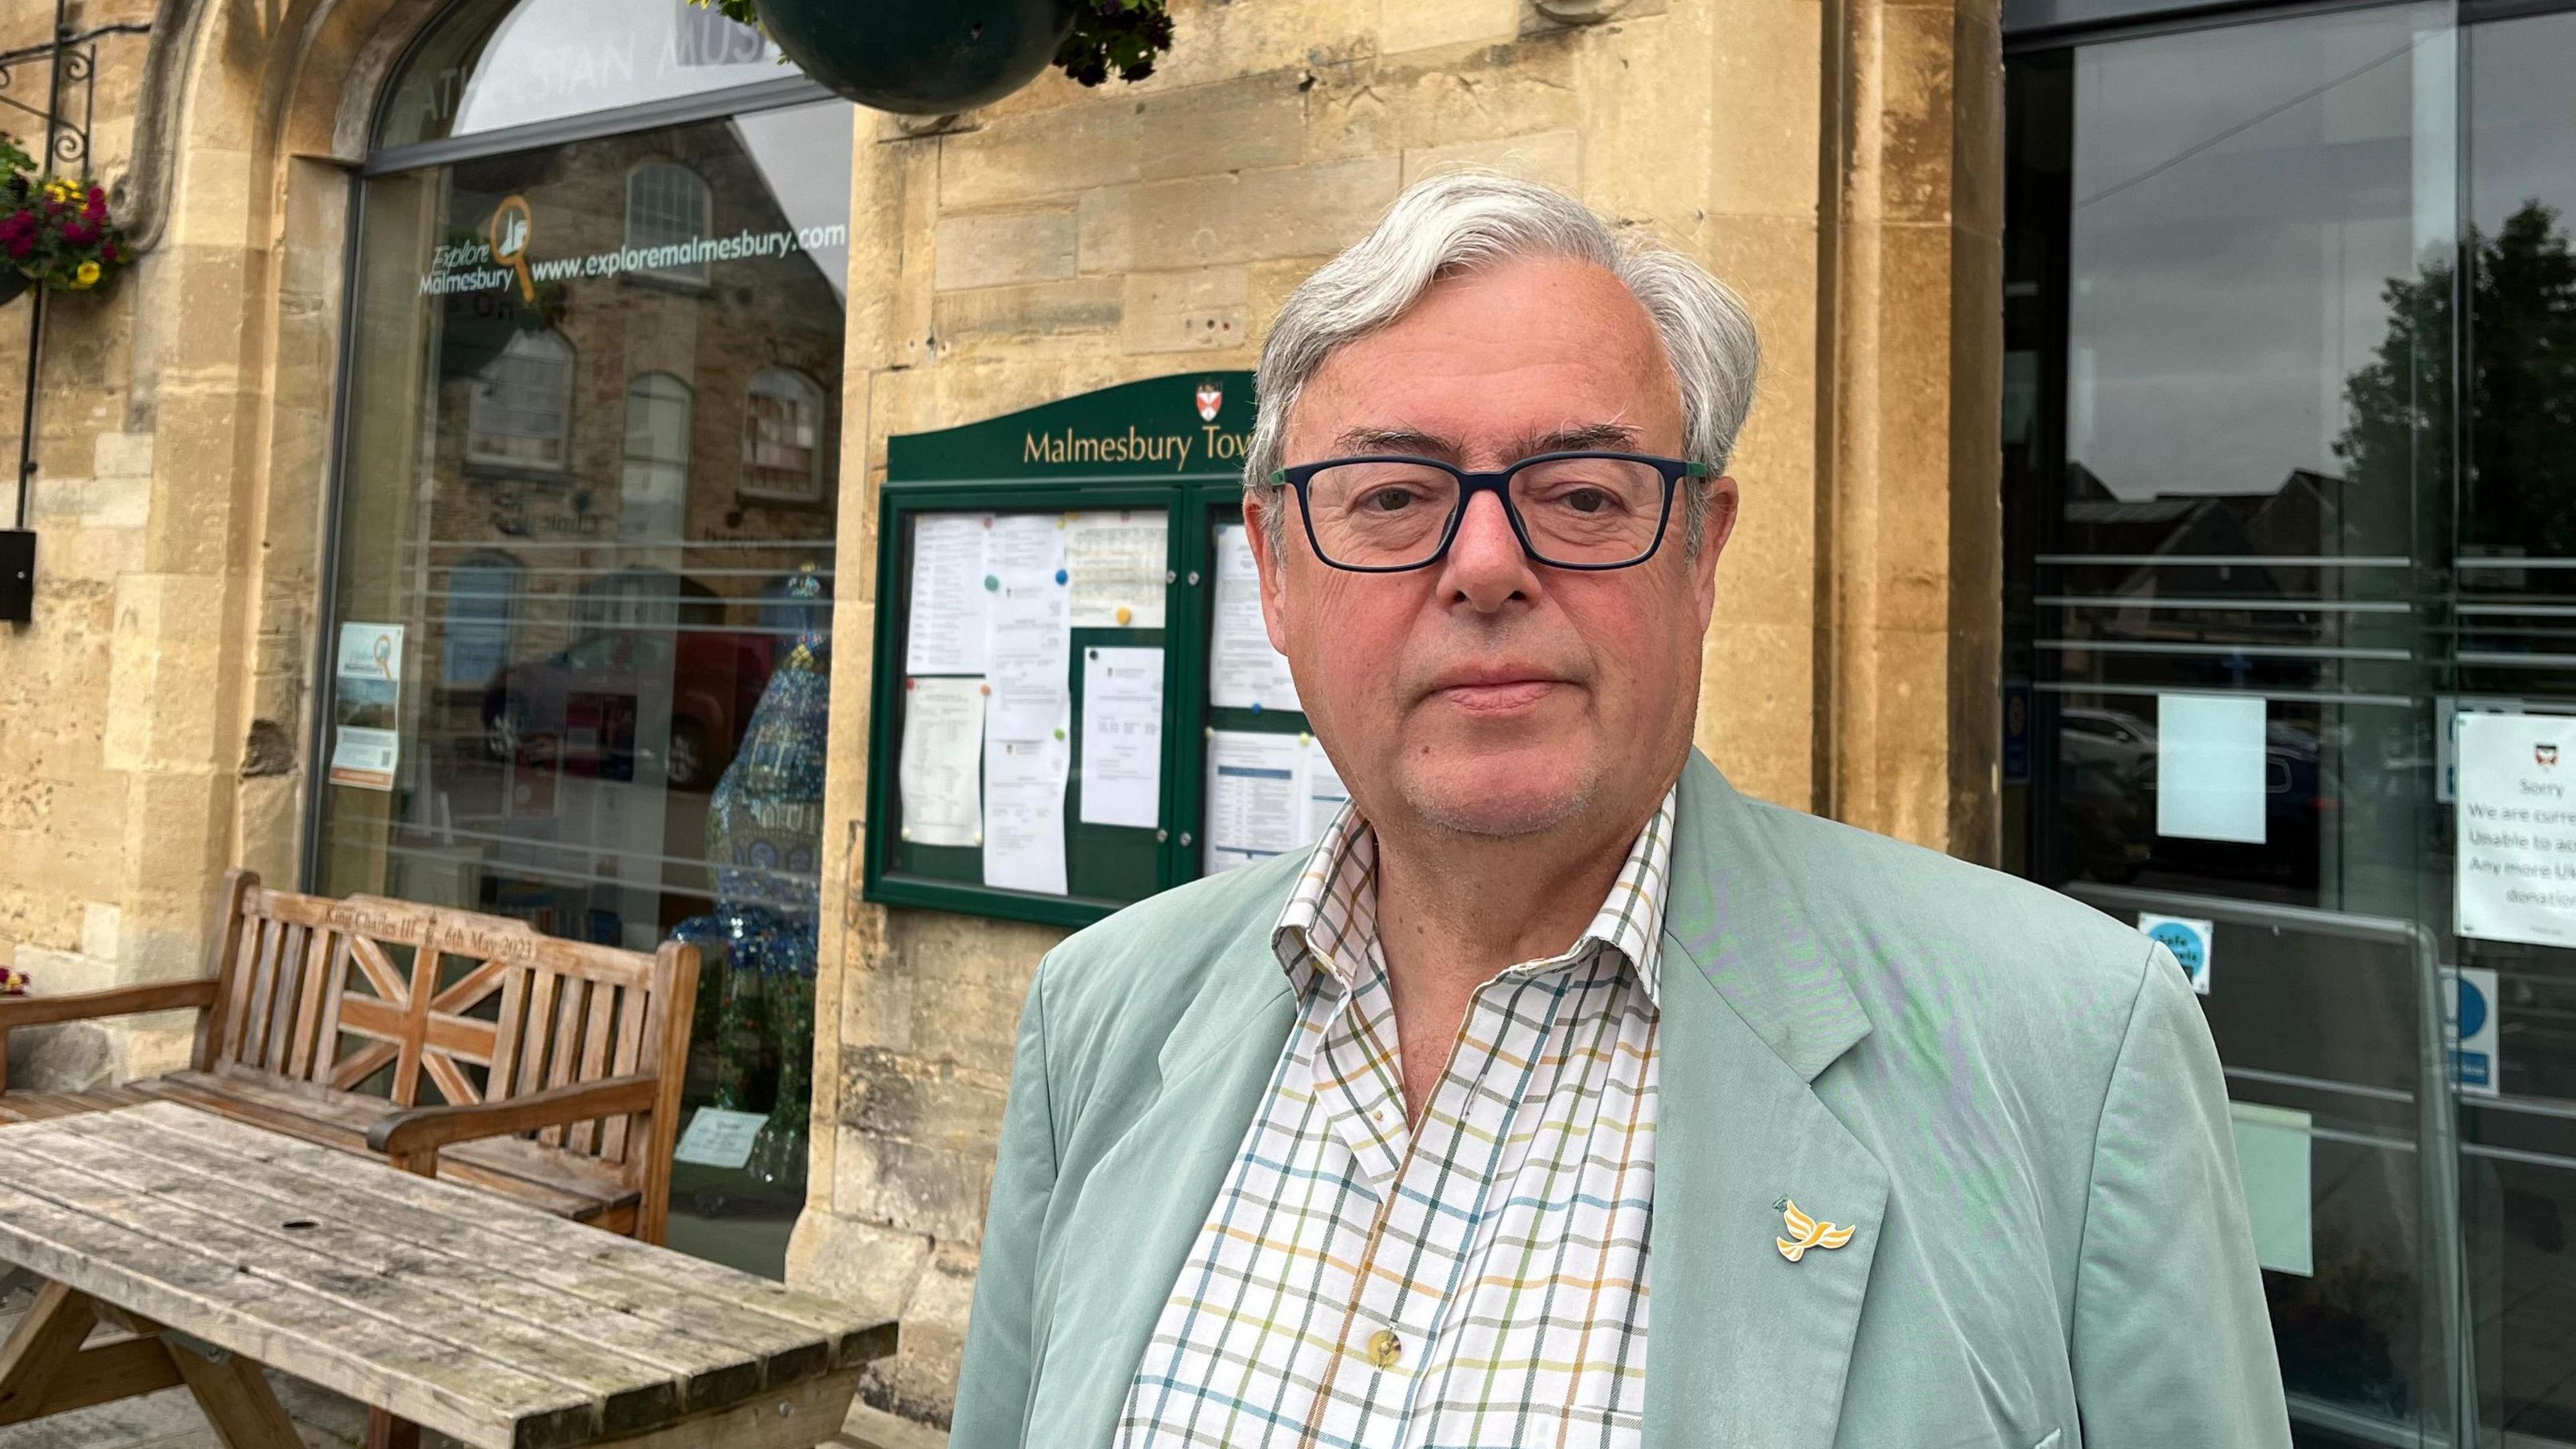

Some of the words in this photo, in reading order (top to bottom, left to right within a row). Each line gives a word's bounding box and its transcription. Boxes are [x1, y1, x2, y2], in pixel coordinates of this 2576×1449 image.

[431, 238, 490, 276] Explore
[532, 223, 846, 282] www.exploremalmesbury.com
[418, 265, 515, 298] Malmesbury
[1024, 425, 1193, 472] Malmesbury
[2518, 778, 2565, 799] Sorry
[2467, 802, 2496, 820] We
[2501, 807, 2530, 822] are
[2468, 828, 2530, 849] Unable
[2533, 834, 2552, 851] to
[2468, 855, 2501, 877] Any
[2504, 862, 2552, 879] more
